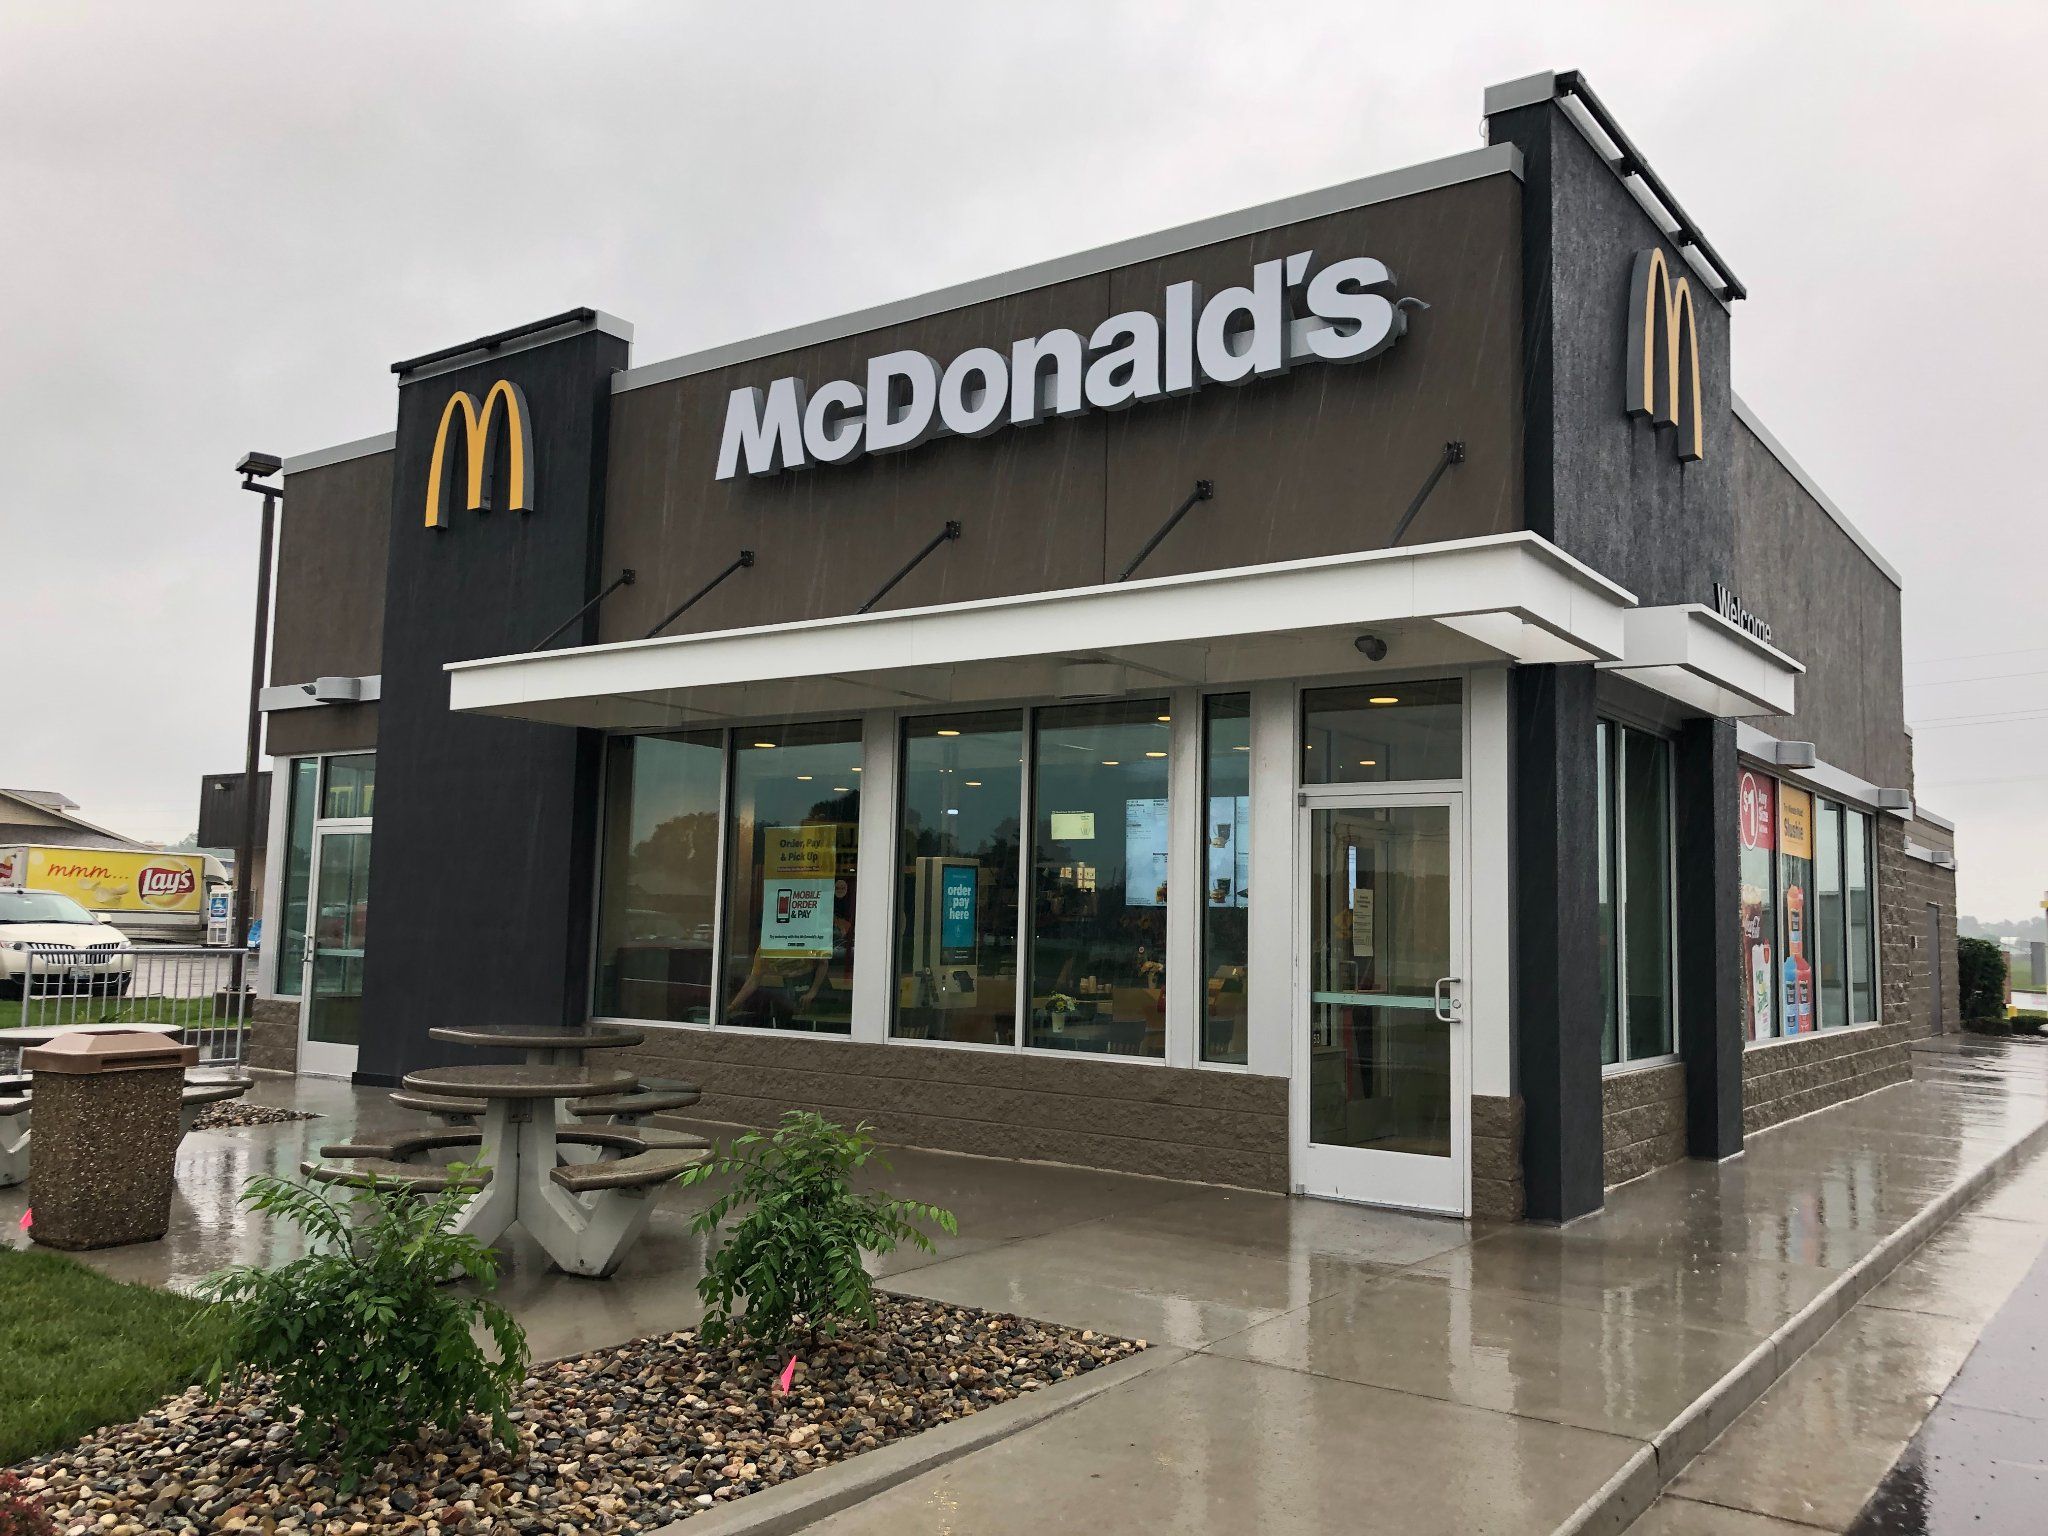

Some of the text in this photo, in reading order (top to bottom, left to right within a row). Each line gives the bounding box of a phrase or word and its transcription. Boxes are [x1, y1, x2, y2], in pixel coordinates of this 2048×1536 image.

[715, 250, 1400, 481] McDonald's
[1713, 583, 1772, 644] Welcome
[780, 839, 821, 849] Order, Pay
[788, 851, 804, 861] Pick
[806, 852, 818, 863] Up
[793, 890, 822, 900] MOBILE
[947, 884, 972, 896] order
[791, 900, 818, 909] ORDER
[952, 897, 970, 909] pay
[791, 909, 811, 918] & PAY
[948, 908, 970, 920] here
